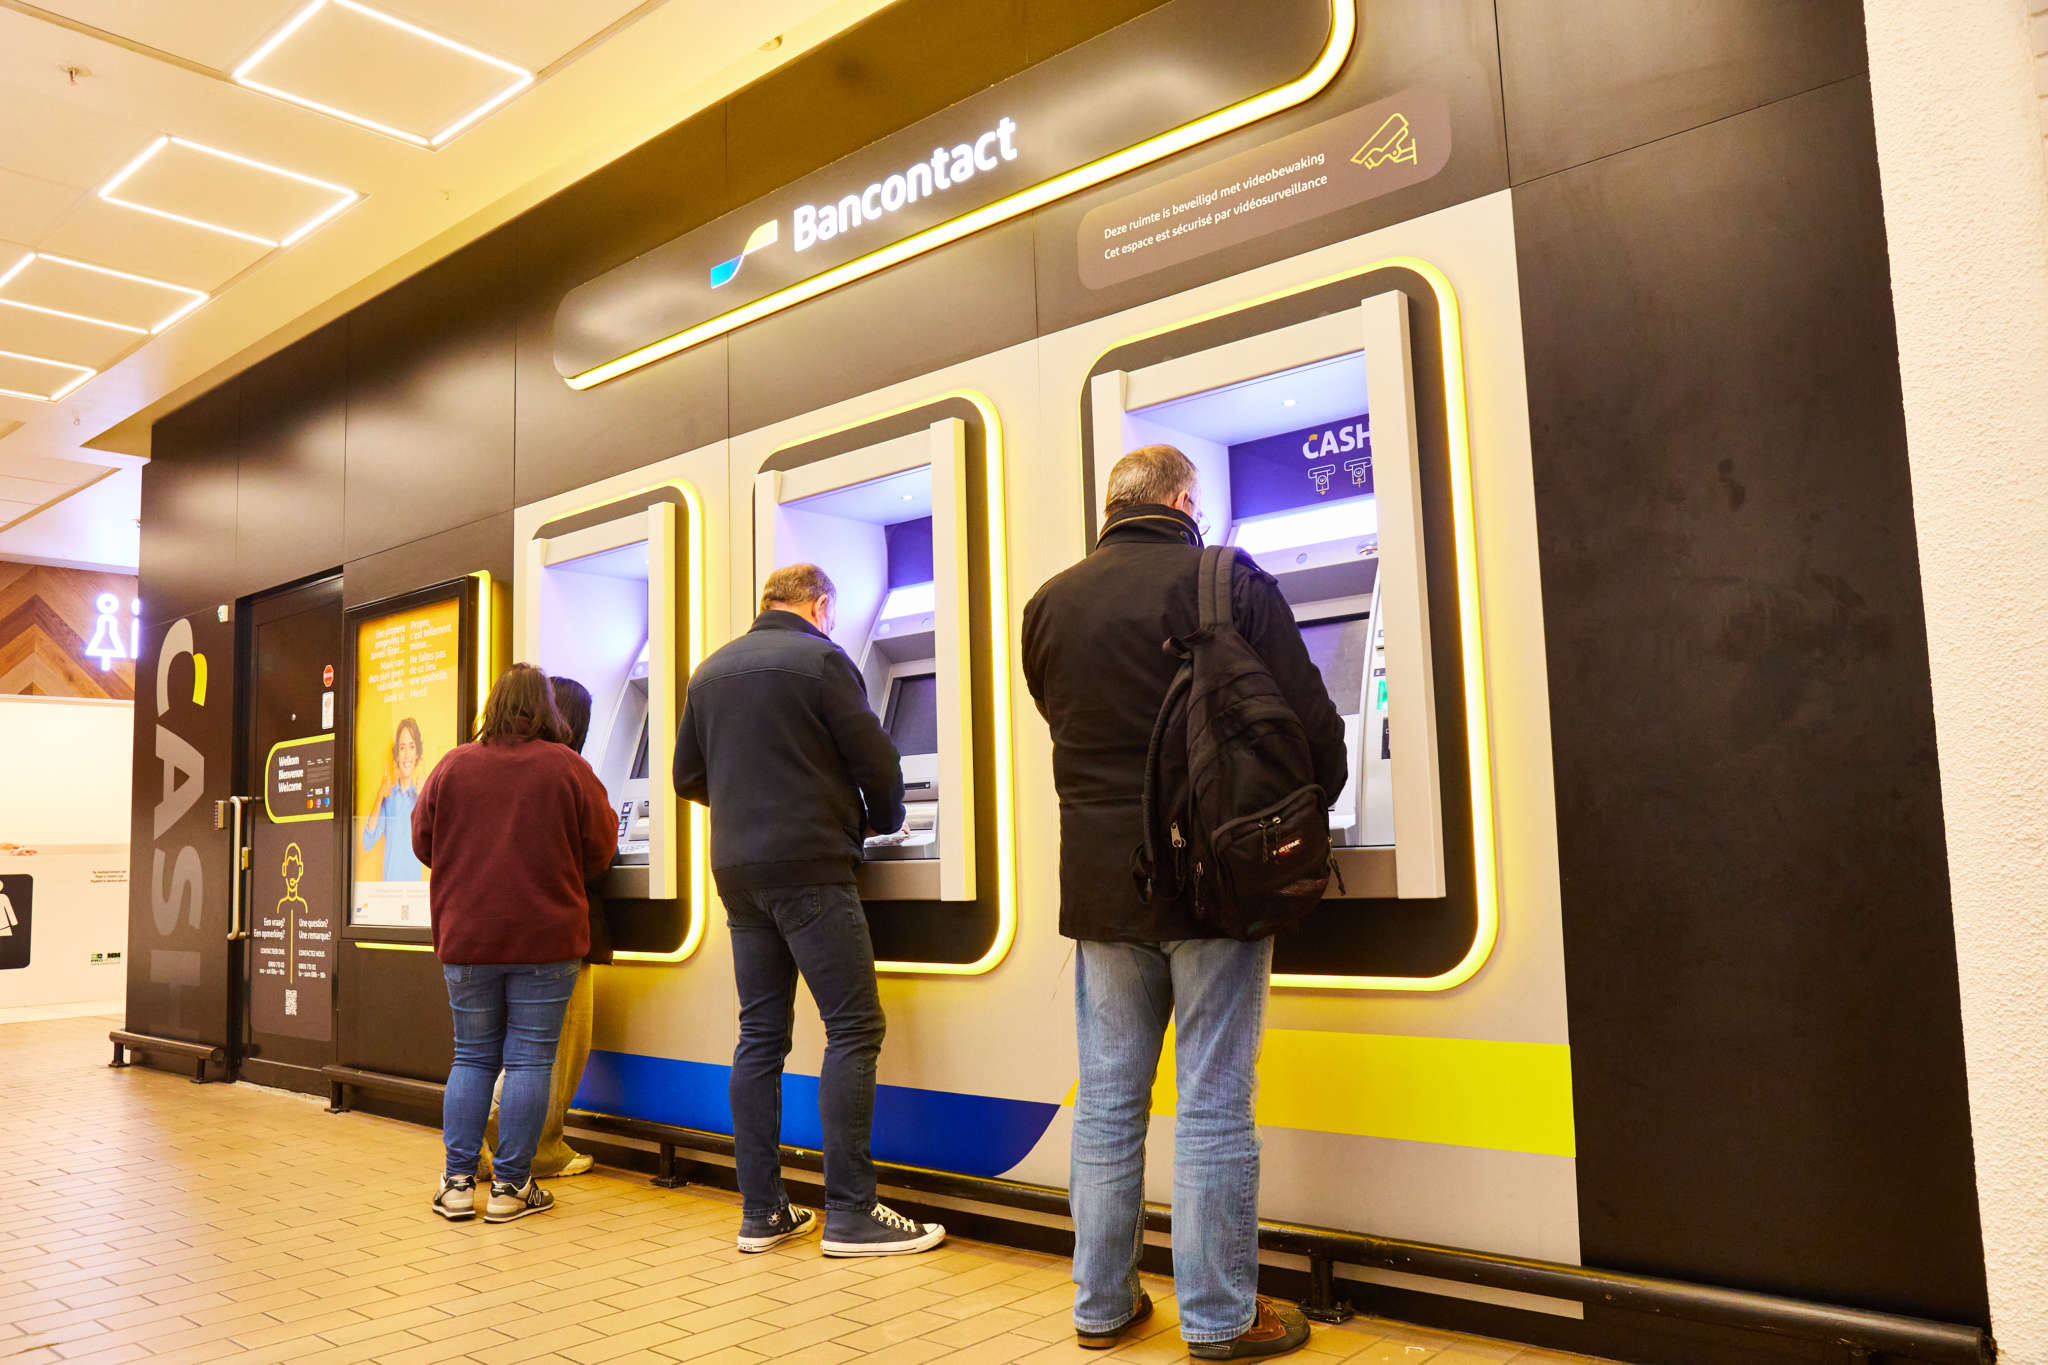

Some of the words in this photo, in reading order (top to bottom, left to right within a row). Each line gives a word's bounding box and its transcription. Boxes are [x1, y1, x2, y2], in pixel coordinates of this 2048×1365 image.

[793, 116, 1018, 252] Bancontact
[1104, 224, 1127, 240] Deze
[1129, 212, 1161, 231] ruimte
[1162, 208, 1171, 220] is
[1172, 191, 1218, 215] beveiligd
[1220, 182, 1241, 198] met
[1243, 152, 1326, 189] videobewaking
[1104, 245, 1120, 260] Cet
[1121, 235, 1154, 255] espace
[1155, 229, 1170, 243] est
[1171, 213, 1213, 237] sécurisé
[1214, 207, 1232, 225] par
[1233, 173, 1328, 216] vidéosurveillance
[1302, 423, 1371, 460] CASH
[279, 755, 299, 767] Welkom
[279, 769, 303, 780] Bienvenue
[278, 782, 301, 792] Welcome
[299, 918, 307, 927] Une
[308, 918, 329, 929] question?
[299, 930, 307, 939] Une
[308, 931, 332, 942] remarque?
